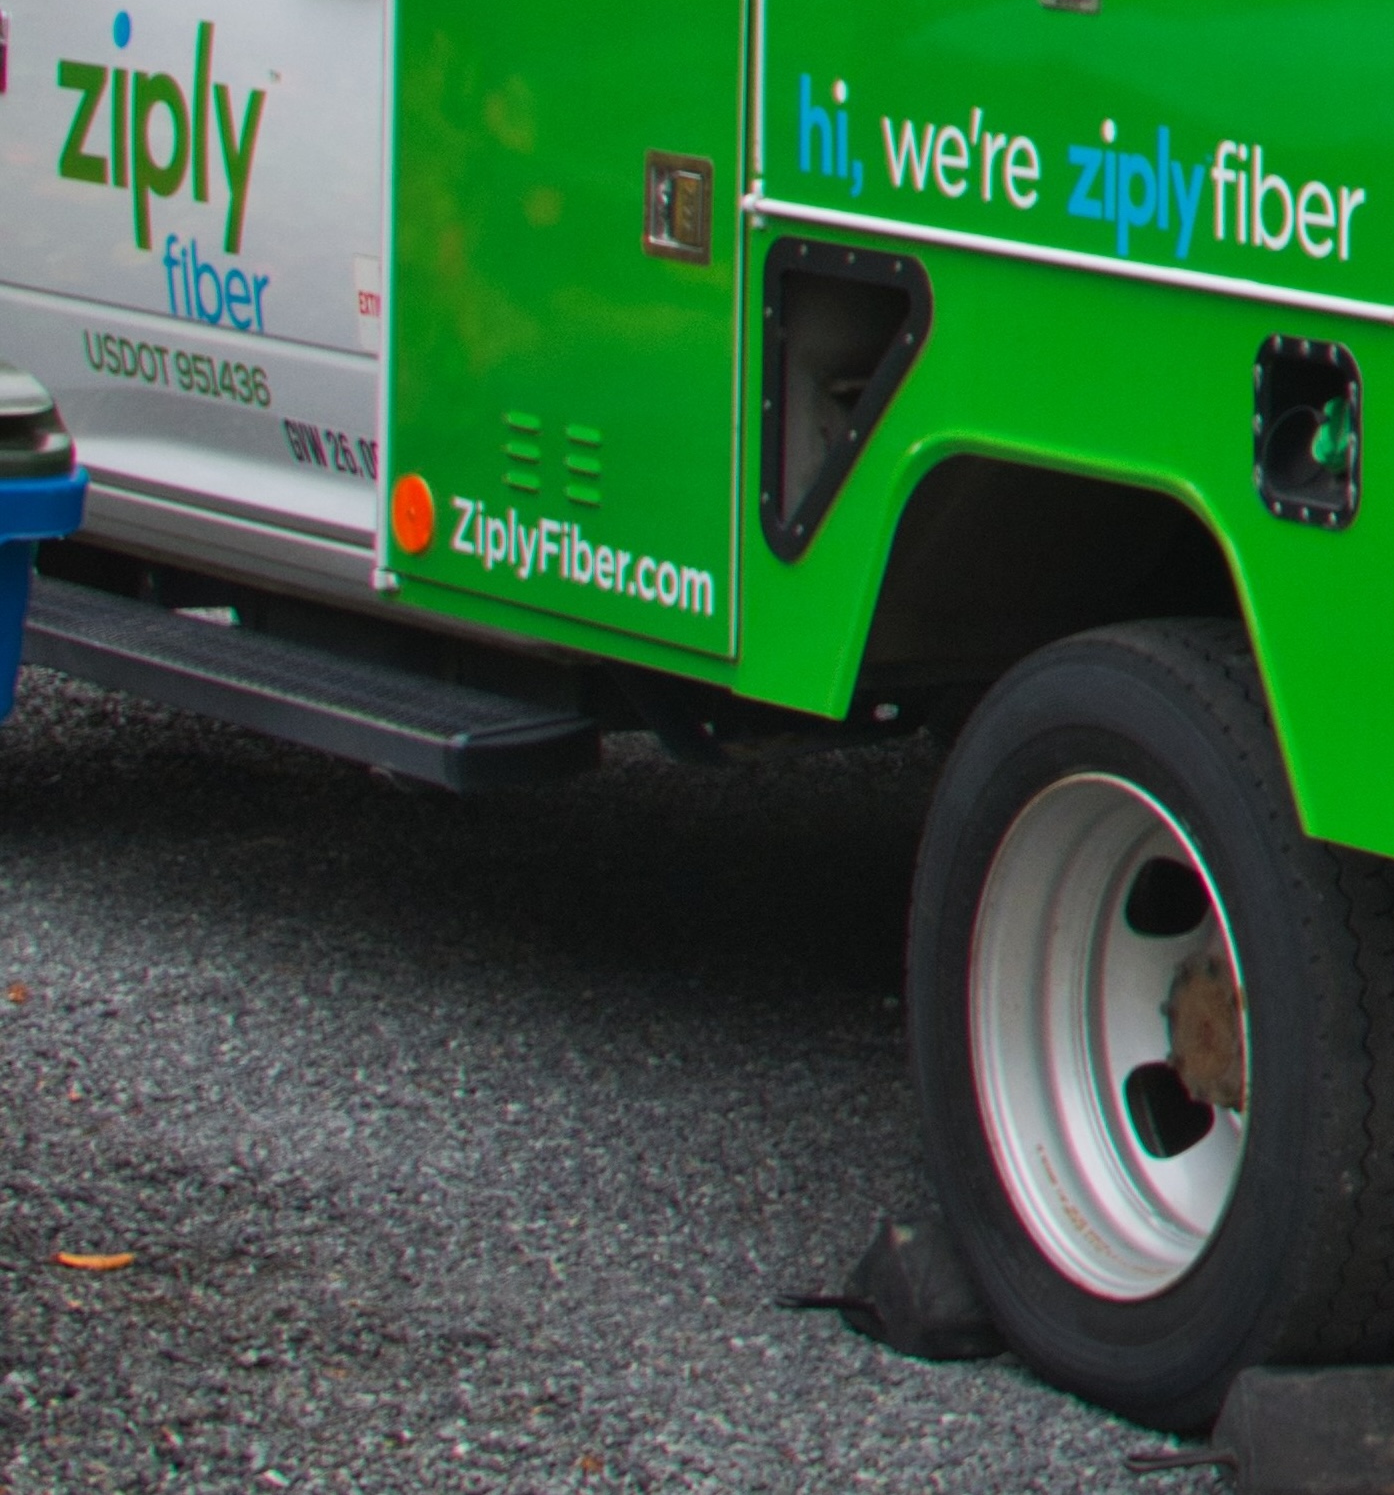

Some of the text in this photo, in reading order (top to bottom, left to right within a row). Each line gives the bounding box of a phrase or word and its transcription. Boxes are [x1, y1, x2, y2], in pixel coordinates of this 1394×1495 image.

[58, 10, 266, 255] ziply
[799, 73, 864, 196] hi,
[882, 106, 1040, 210] we're
[163, 232, 269, 334] fiber
[84, 329, 271, 408] USDOT 951436
[452, 495, 714, 616] ZiplyFiber.com
